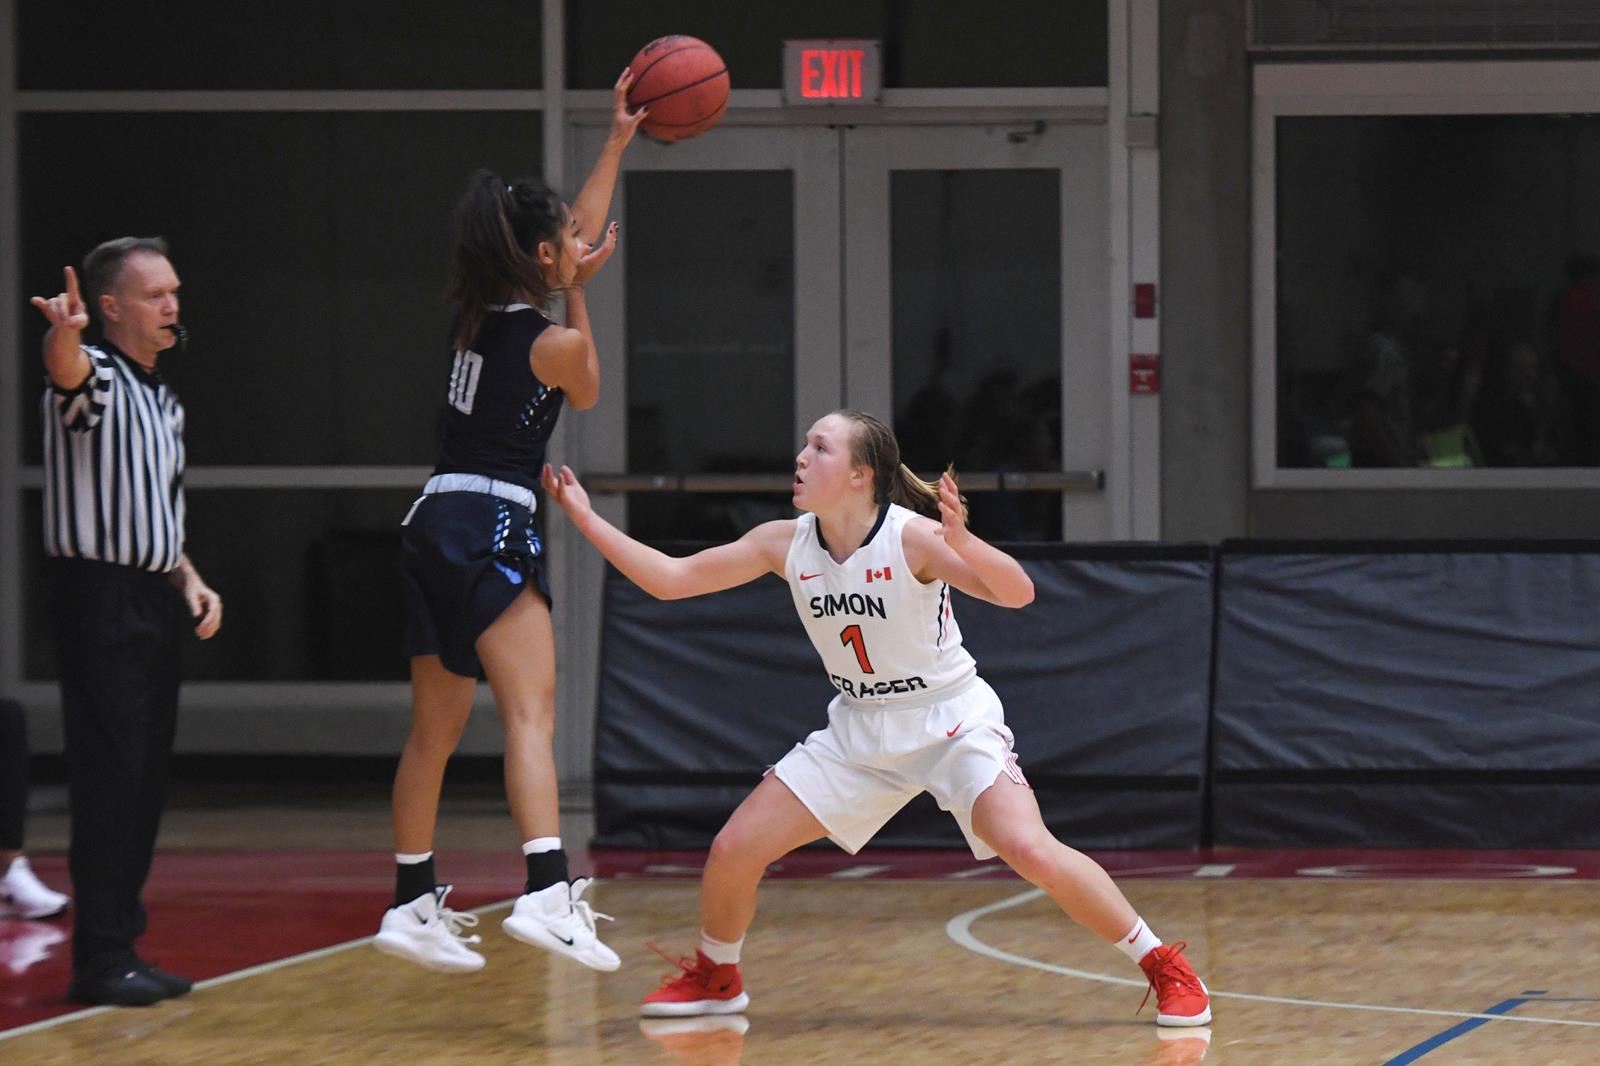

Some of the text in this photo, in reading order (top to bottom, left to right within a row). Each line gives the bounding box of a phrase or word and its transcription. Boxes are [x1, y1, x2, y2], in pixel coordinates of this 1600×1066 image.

[801, 49, 865, 98] EXIT
[447, 349, 484, 416] 10
[810, 593, 887, 618] SIMON
[840, 624, 875, 674] 1
